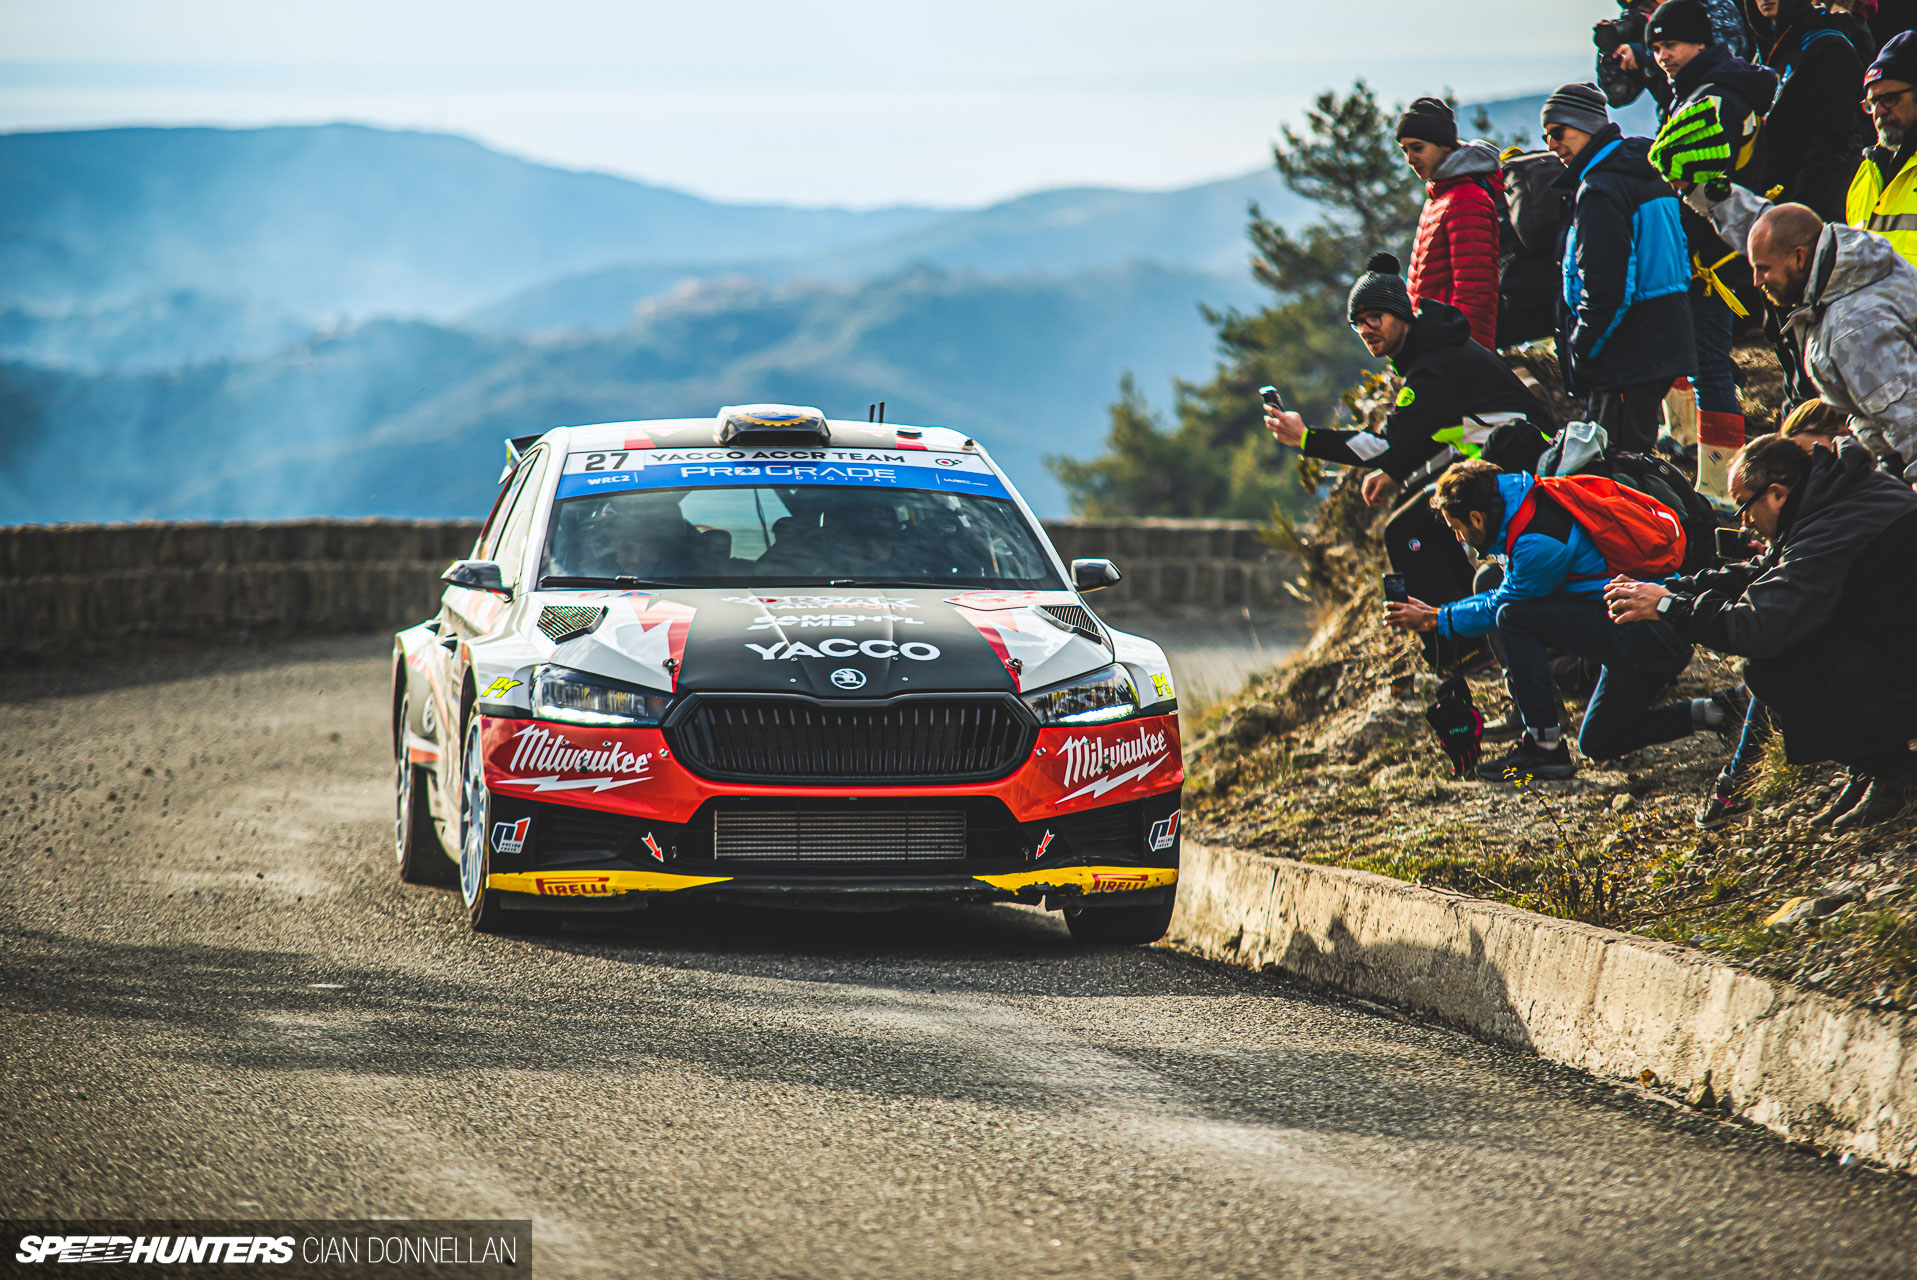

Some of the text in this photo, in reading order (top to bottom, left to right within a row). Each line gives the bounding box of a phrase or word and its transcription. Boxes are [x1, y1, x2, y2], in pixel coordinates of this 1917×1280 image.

[585, 452, 630, 472] 27
[650, 450, 906, 463] YACCO ACCR TEAM
[587, 475, 630, 486] WRC2
[796, 475, 897, 484] DIGITAL
[745, 638, 941, 661] YACCO
[509, 723, 651, 774] Milwaukee
[1056, 726, 1168, 789] Milwaukee
[536, 876, 610, 896] PIRELLI
[1091, 872, 1150, 892] PIRELLI
